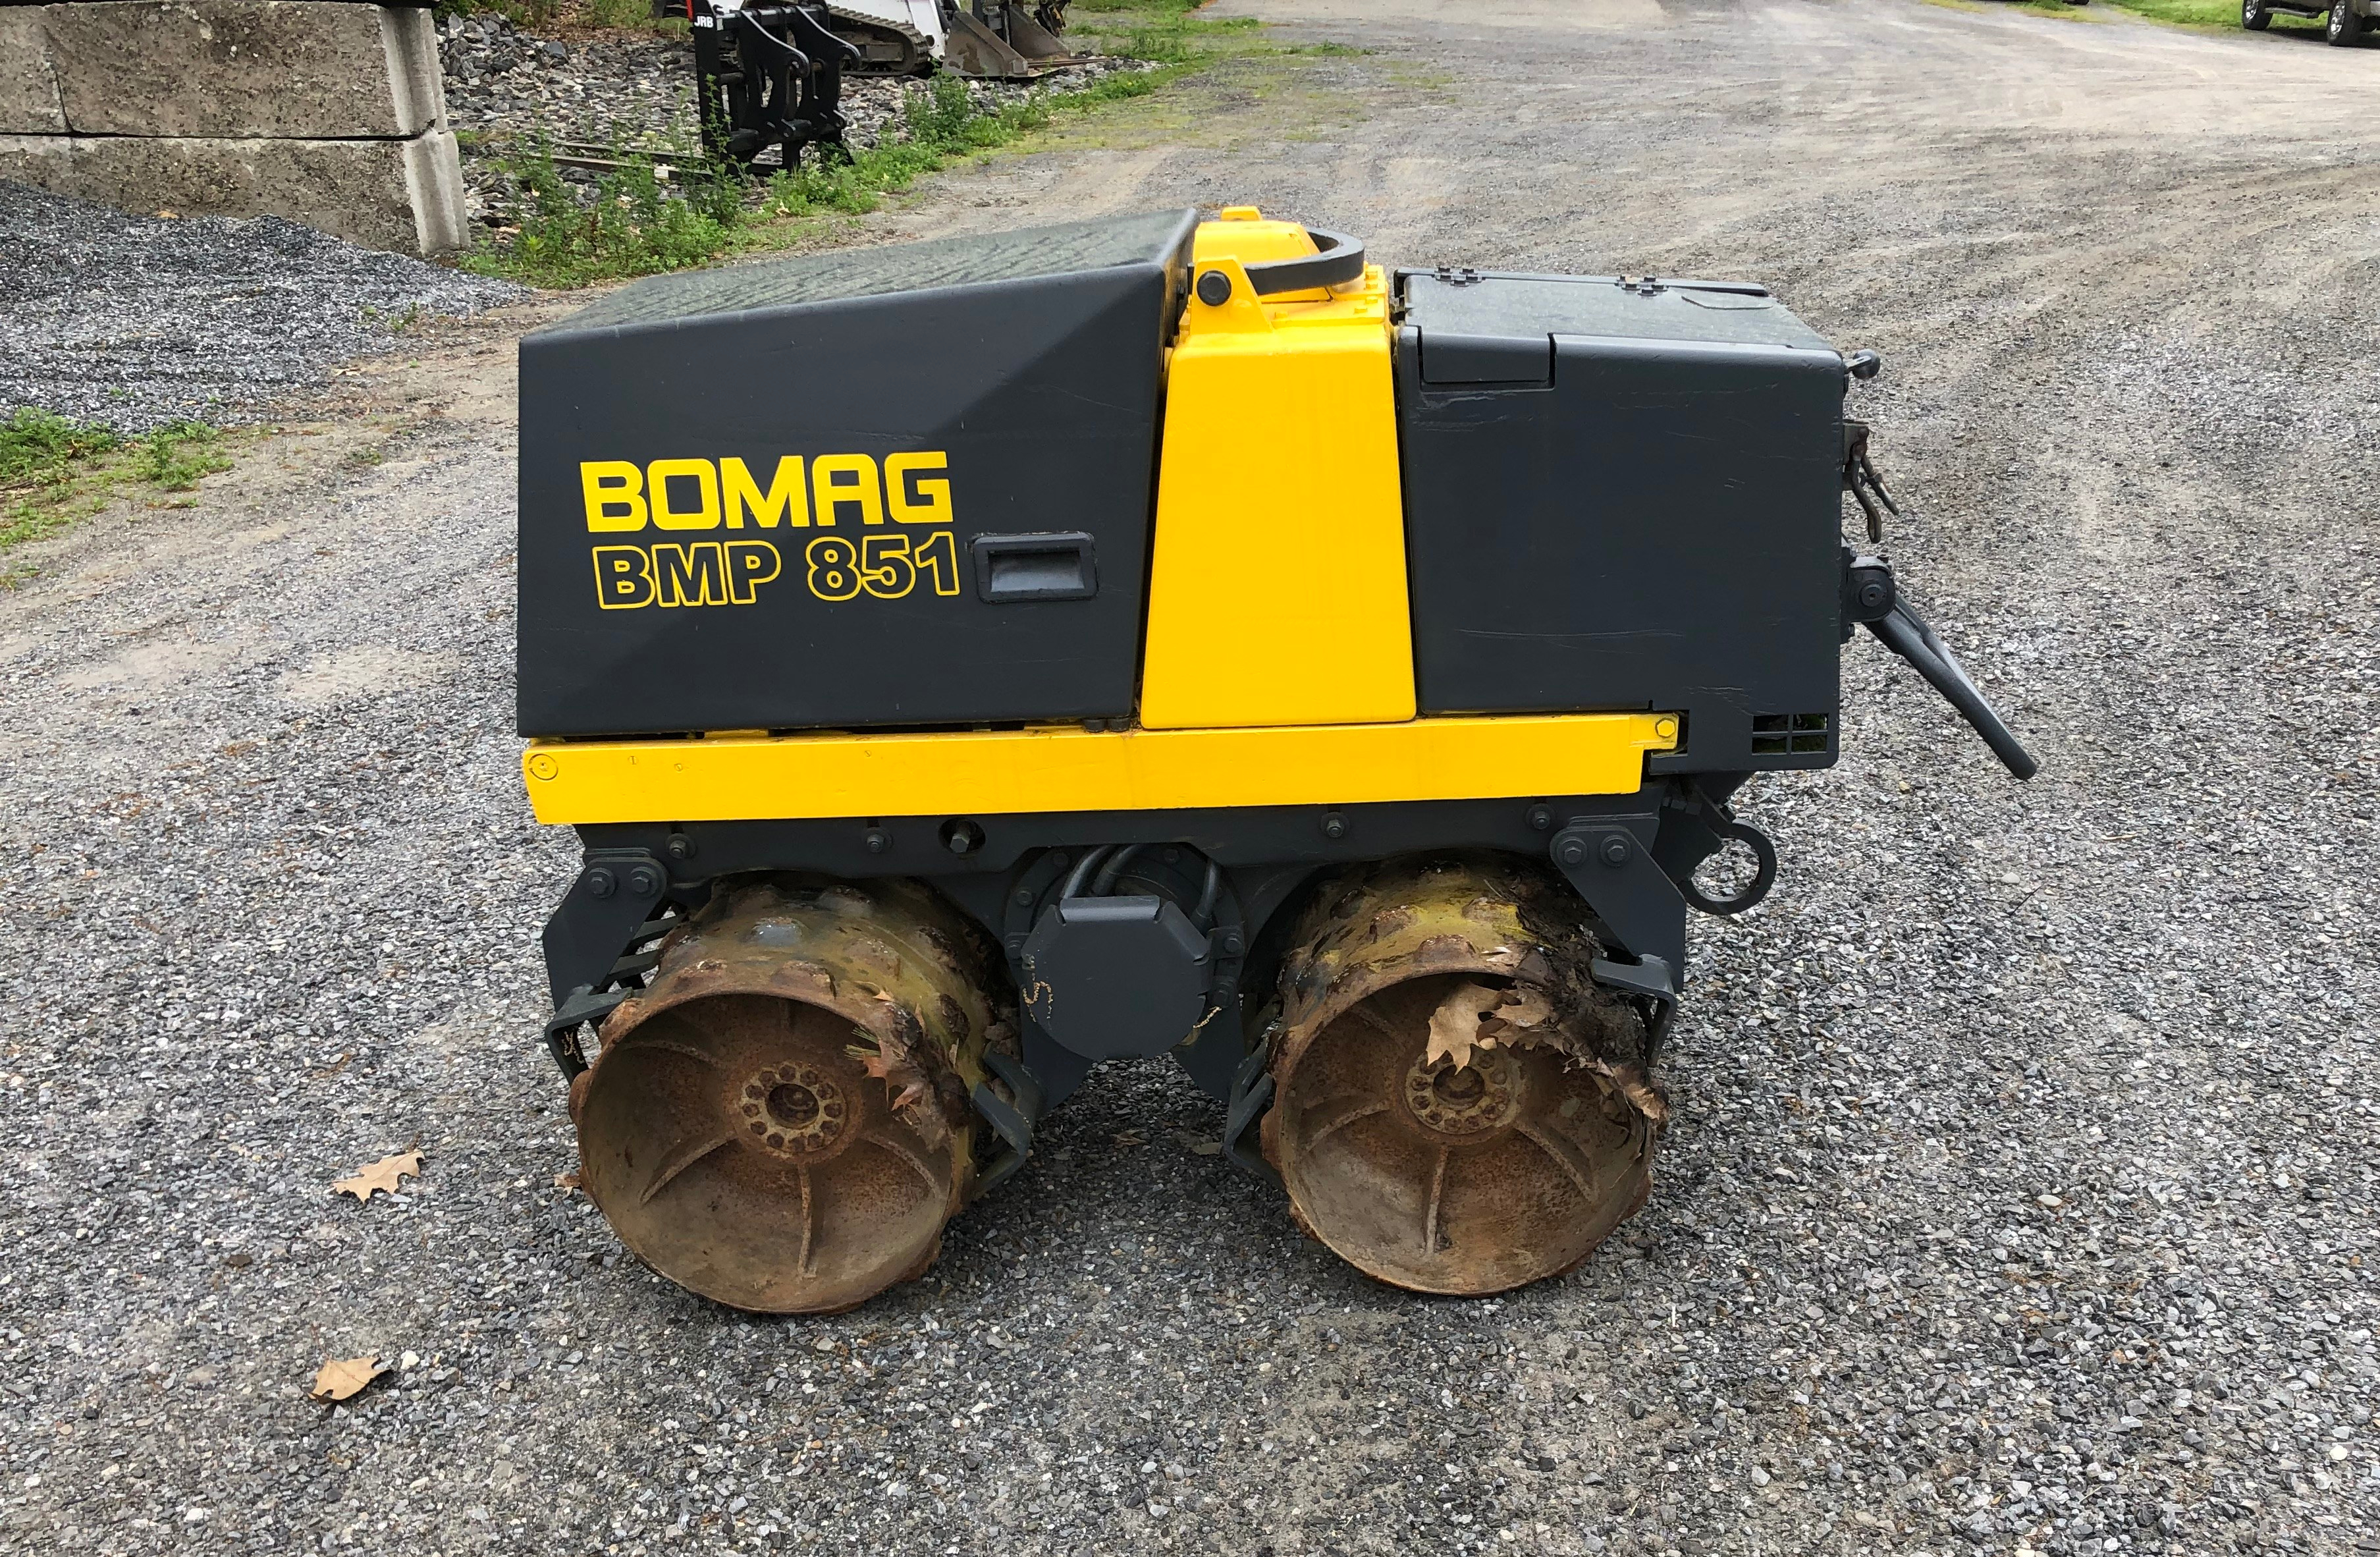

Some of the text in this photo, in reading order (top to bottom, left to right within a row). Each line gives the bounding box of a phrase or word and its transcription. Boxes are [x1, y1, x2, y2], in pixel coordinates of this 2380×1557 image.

[693, 15, 714, 28] JRB
[580, 451, 954, 533] BOMAG
[591, 531, 960, 610] BMP 851
